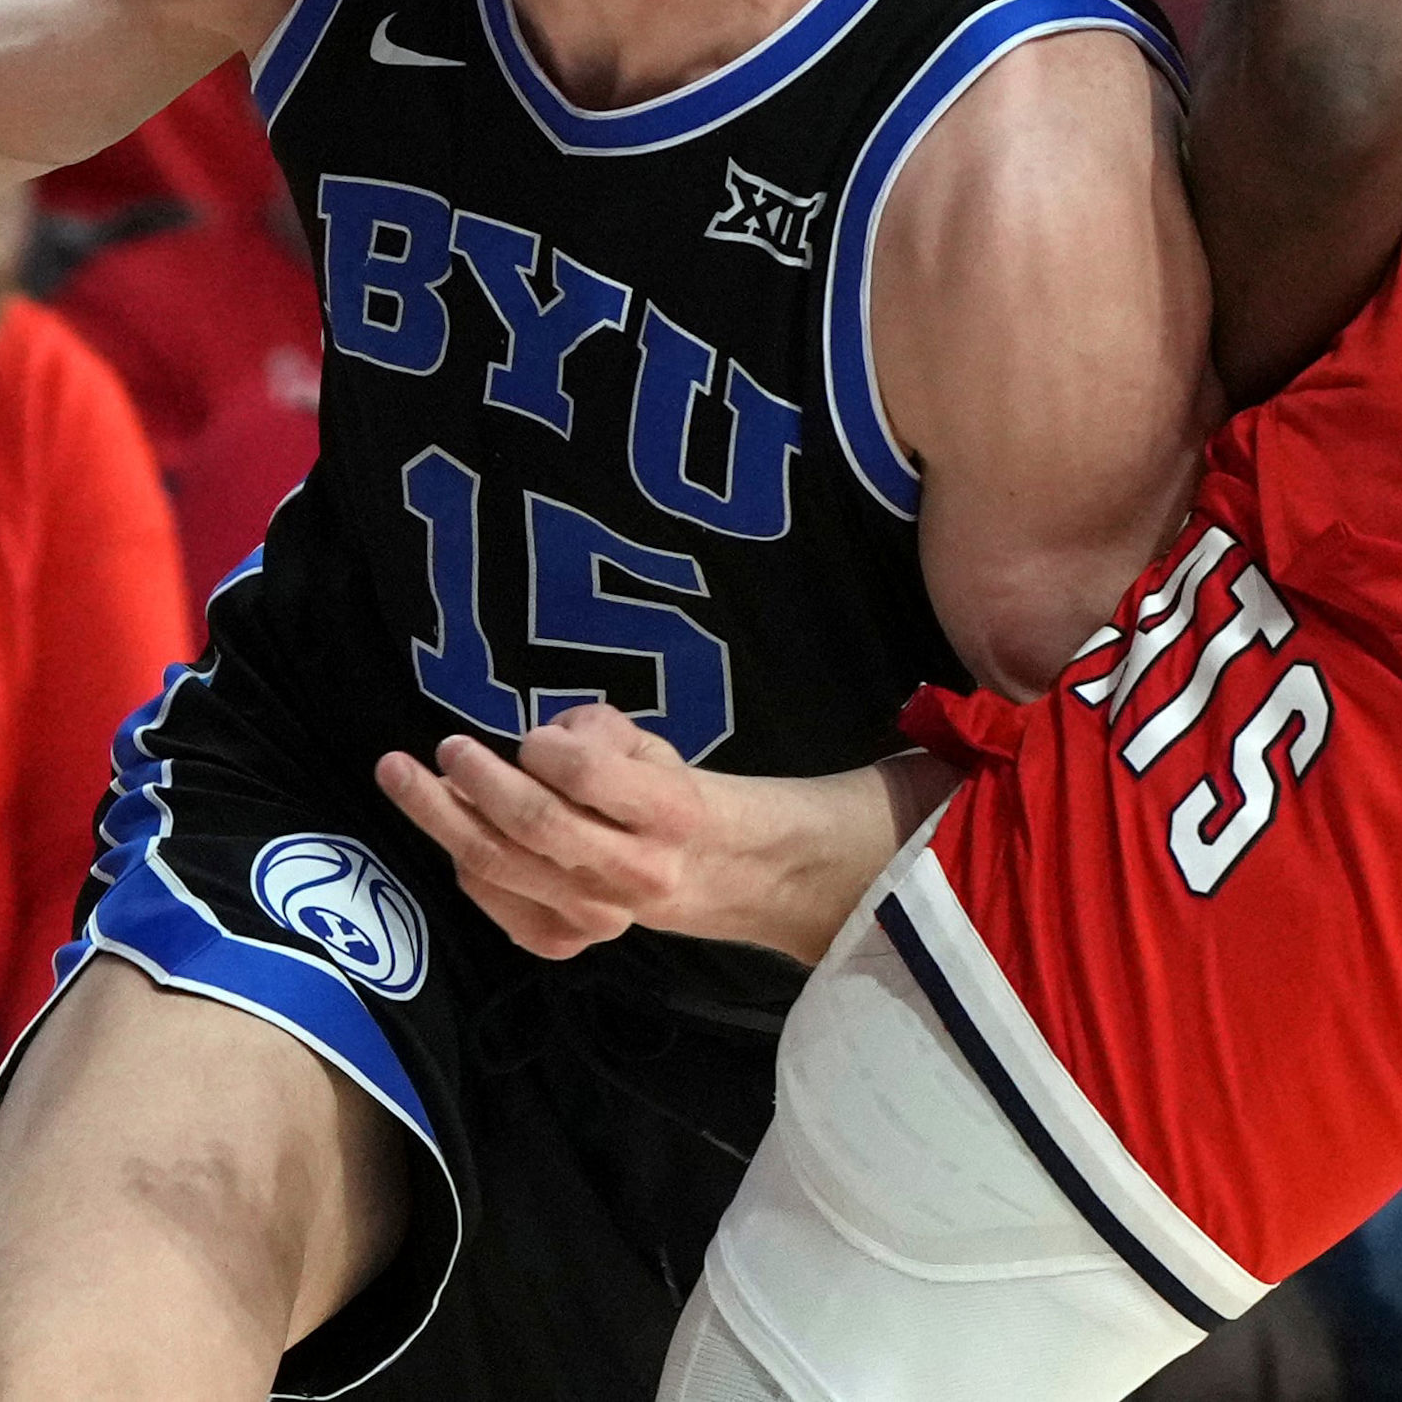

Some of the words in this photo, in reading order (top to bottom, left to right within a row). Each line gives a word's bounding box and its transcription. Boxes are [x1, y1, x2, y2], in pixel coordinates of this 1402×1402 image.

[317, 173, 803, 542] BYU
[402, 444, 735, 767] 15
[315, 910, 370, 954] Y
